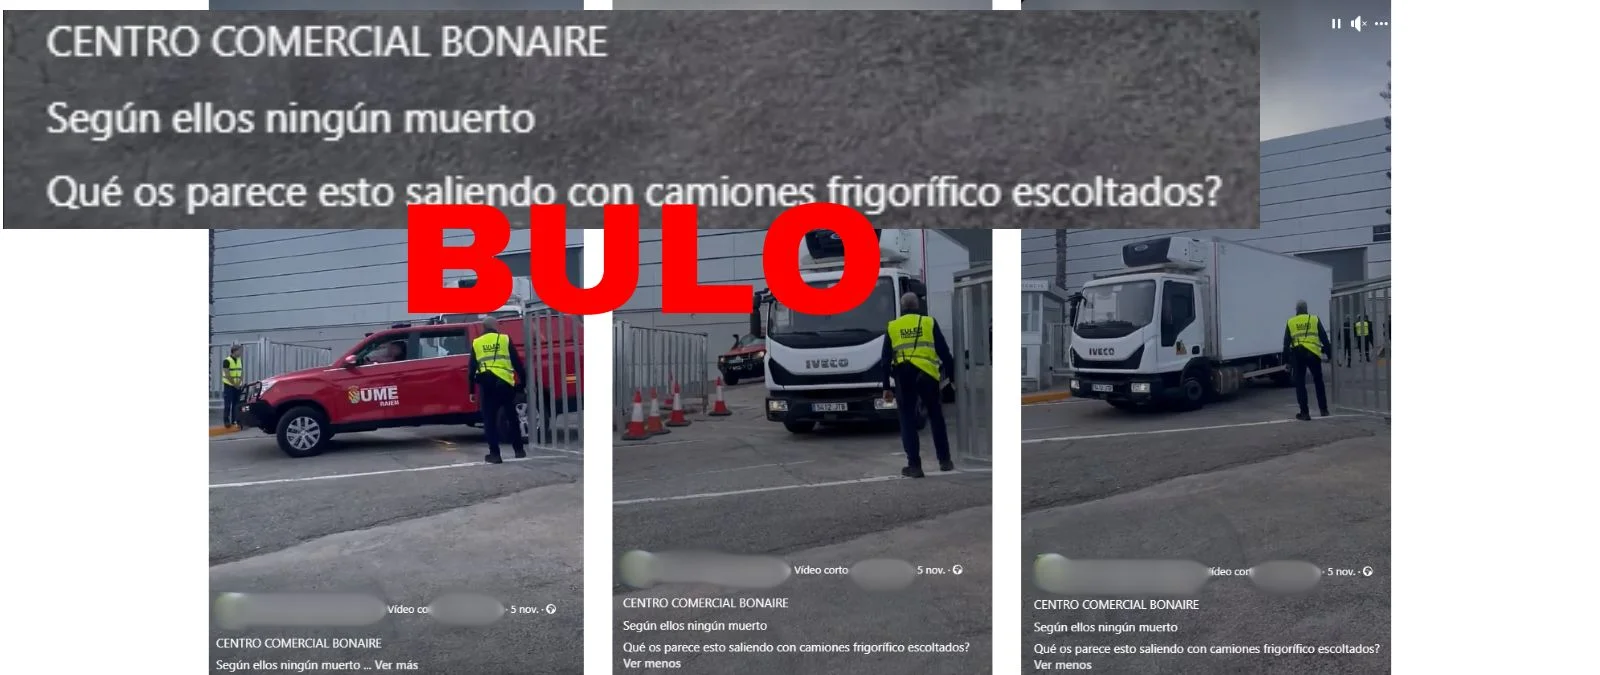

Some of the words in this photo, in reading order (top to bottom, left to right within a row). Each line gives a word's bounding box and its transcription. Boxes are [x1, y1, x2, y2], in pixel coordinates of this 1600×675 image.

[1089, 347, 1115, 356] IVECO
[805, 358, 849, 369] IVECO
[360, 387, 399, 402] UME
